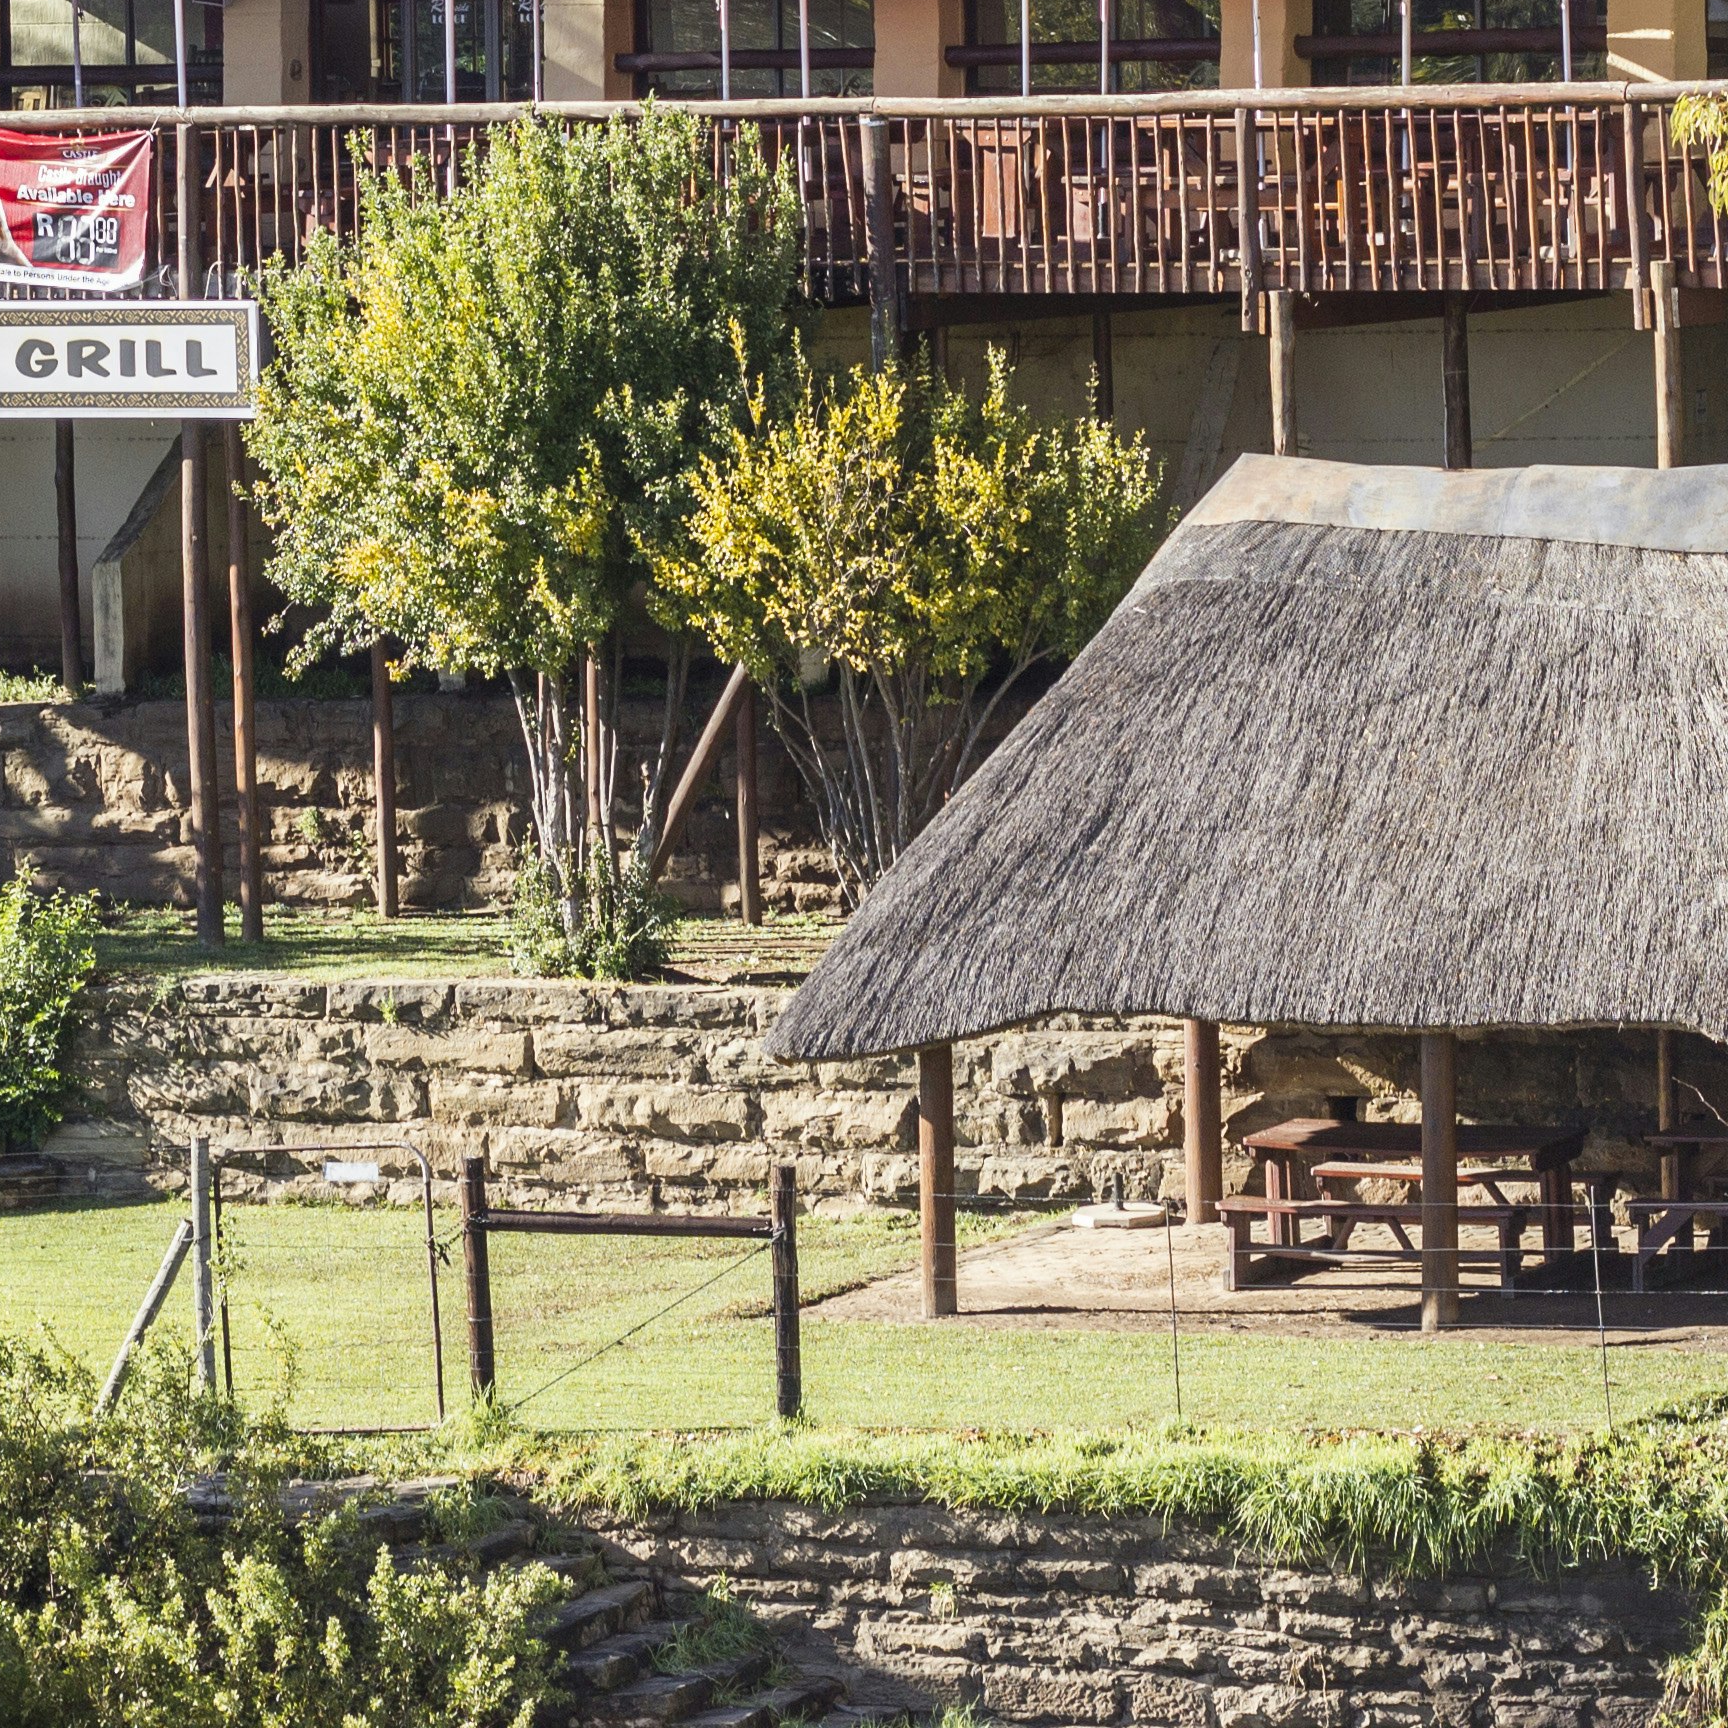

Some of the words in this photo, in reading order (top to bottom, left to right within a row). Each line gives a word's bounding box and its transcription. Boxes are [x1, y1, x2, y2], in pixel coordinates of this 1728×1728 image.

[62, 150, 100, 159] CASTLE
[16, 184, 94, 204] Available
[98, 190, 136, 209] Here
[13, 269, 22, 277] to
[23, 270, 55, 280] Persons
[57, 273, 80, 282] Under
[15, 338, 218, 378] GRILL
